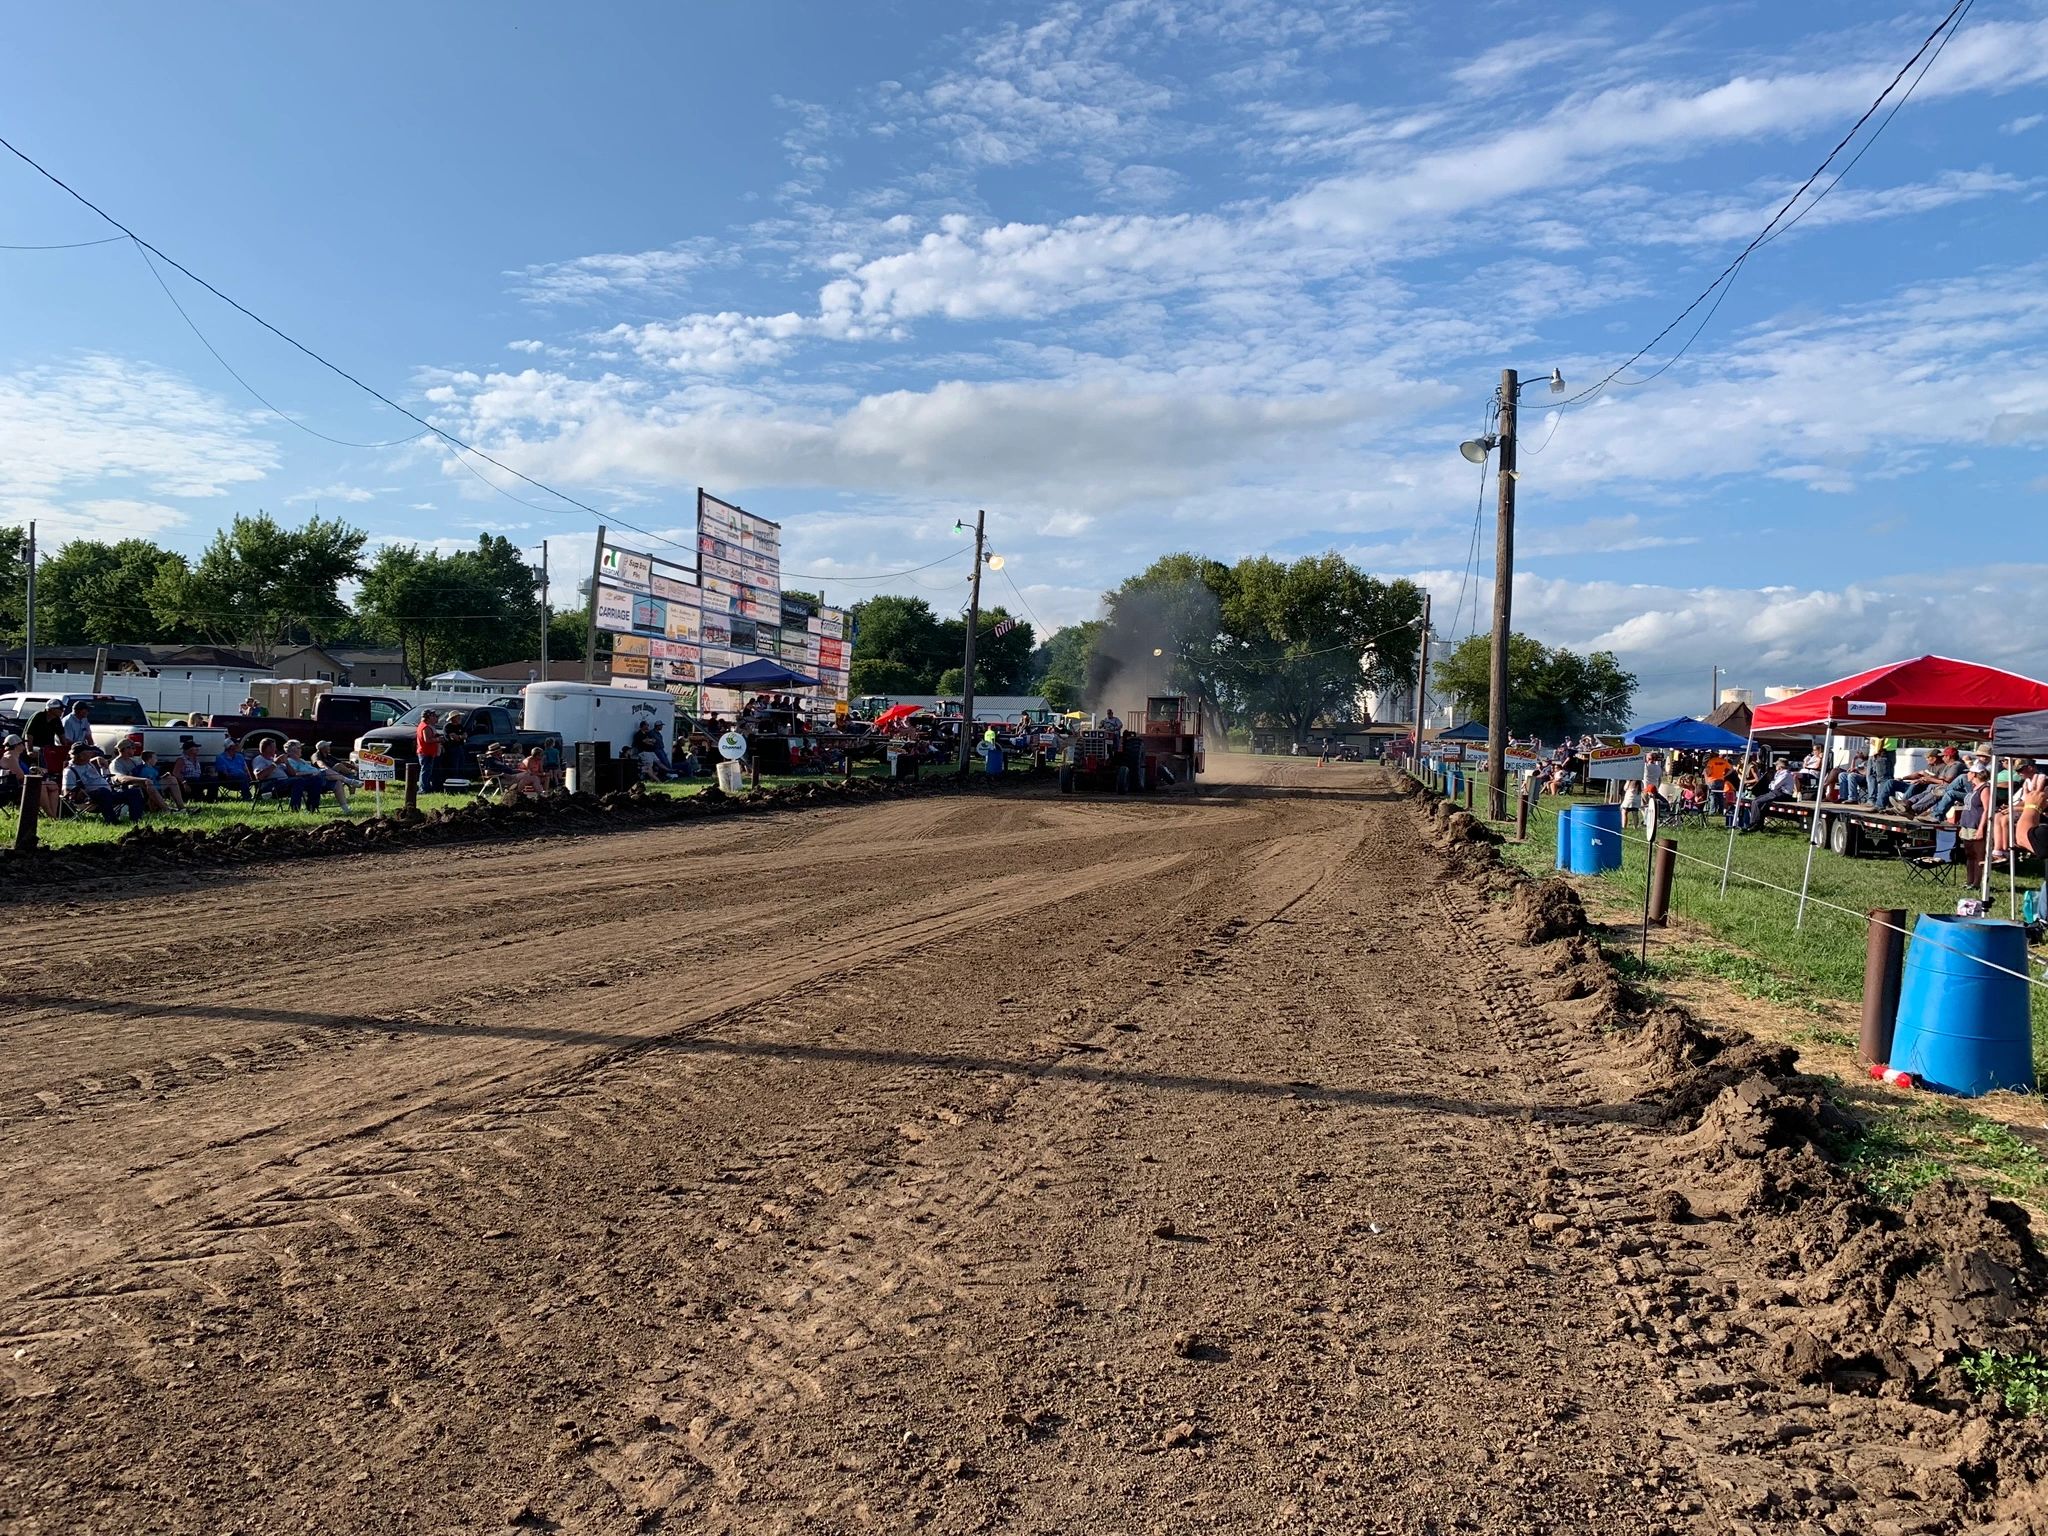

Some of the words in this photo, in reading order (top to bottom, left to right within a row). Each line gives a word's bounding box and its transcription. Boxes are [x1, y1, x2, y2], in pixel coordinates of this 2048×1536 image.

[599, 606, 630, 621] CARRIAGE
[1510, 750, 1532, 758] DEKALB
[1600, 747, 1633, 757] DEKALB
[363, 752, 388, 764] DEKALB
